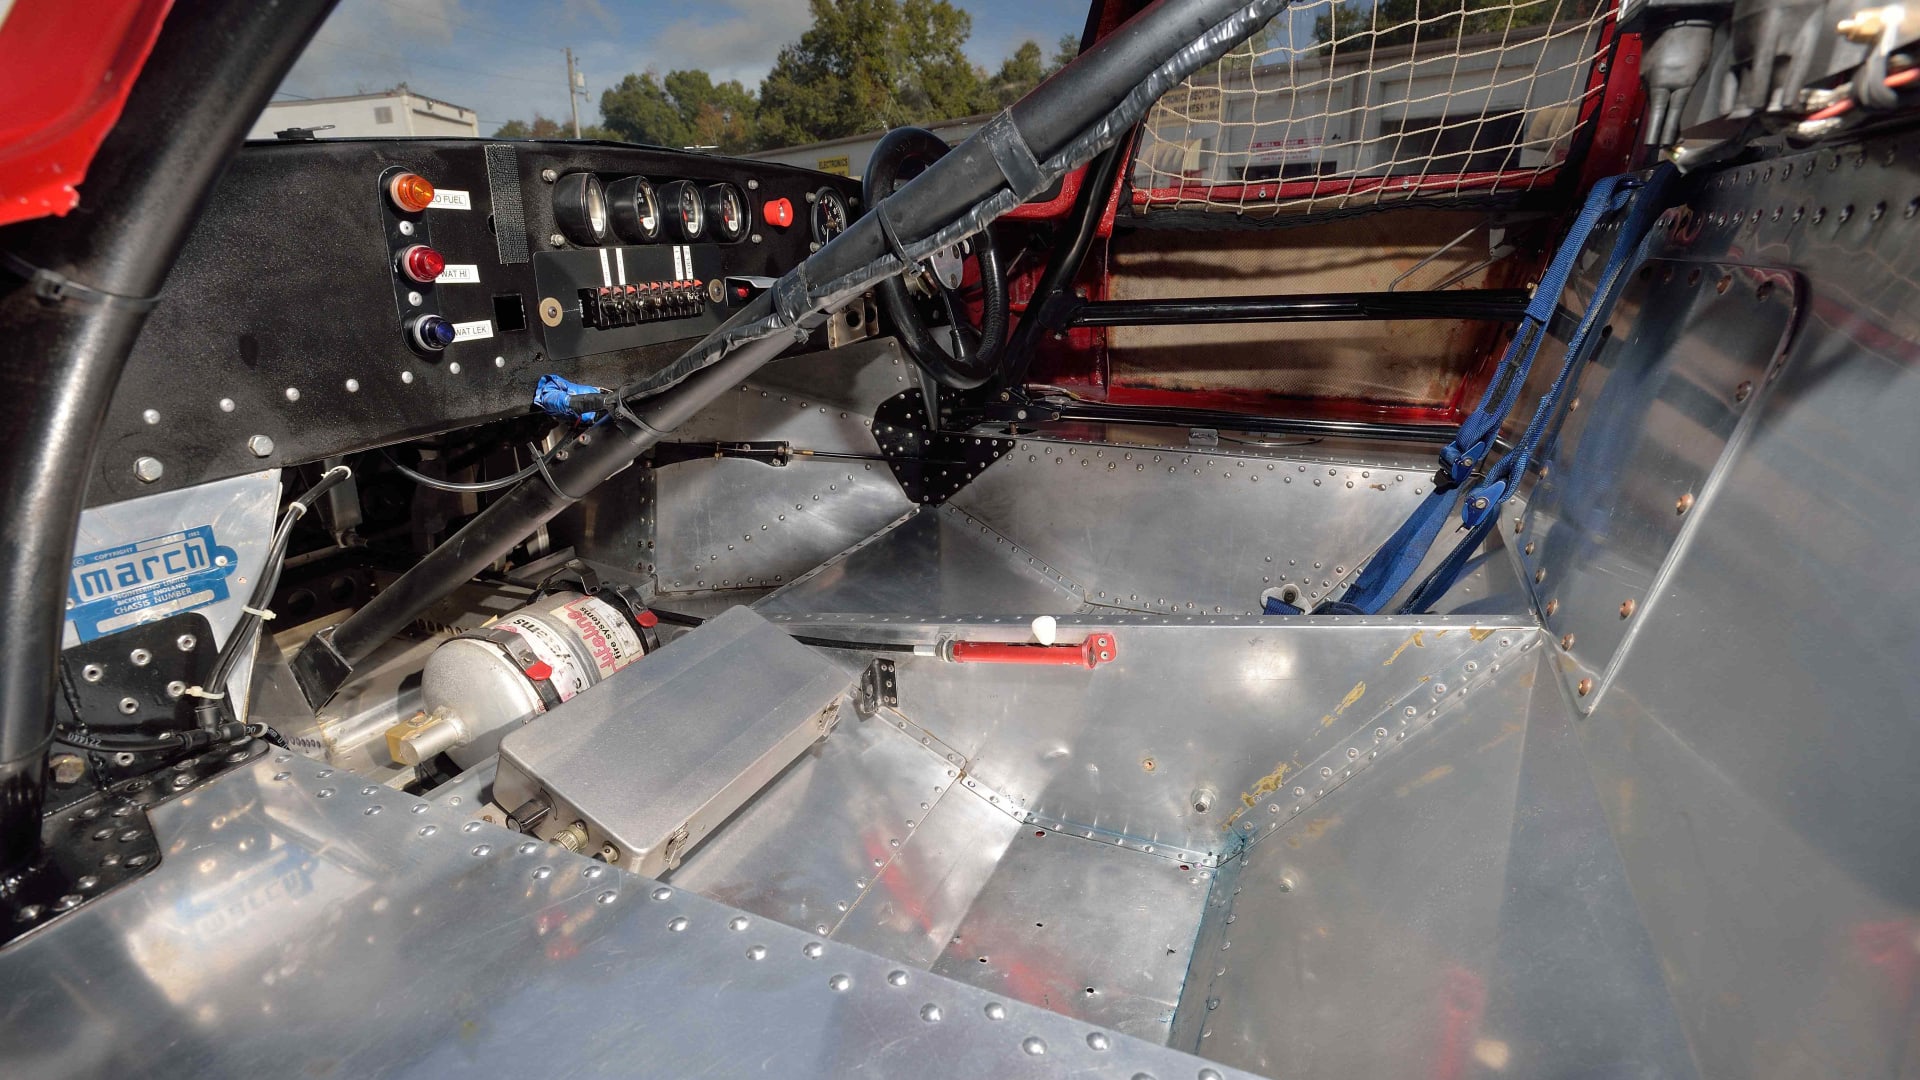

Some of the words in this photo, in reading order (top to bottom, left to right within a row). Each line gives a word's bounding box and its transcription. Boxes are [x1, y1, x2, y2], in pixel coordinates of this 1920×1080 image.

[443, 195, 464, 204] FUEL
[459, 269, 467, 278] HI
[455, 327, 471, 336] WAT
[472, 325, 487, 335] LEK
[94, 547, 134, 561] COPYRIGHT
[80, 542, 206, 597] march
[112, 583, 161, 601] ENGINEERING
[114, 600, 151, 615] CHASSIS
[153, 587, 193, 604] NUMBER
[580, 606, 612, 640] systems
[610, 642, 622, 660] fire
